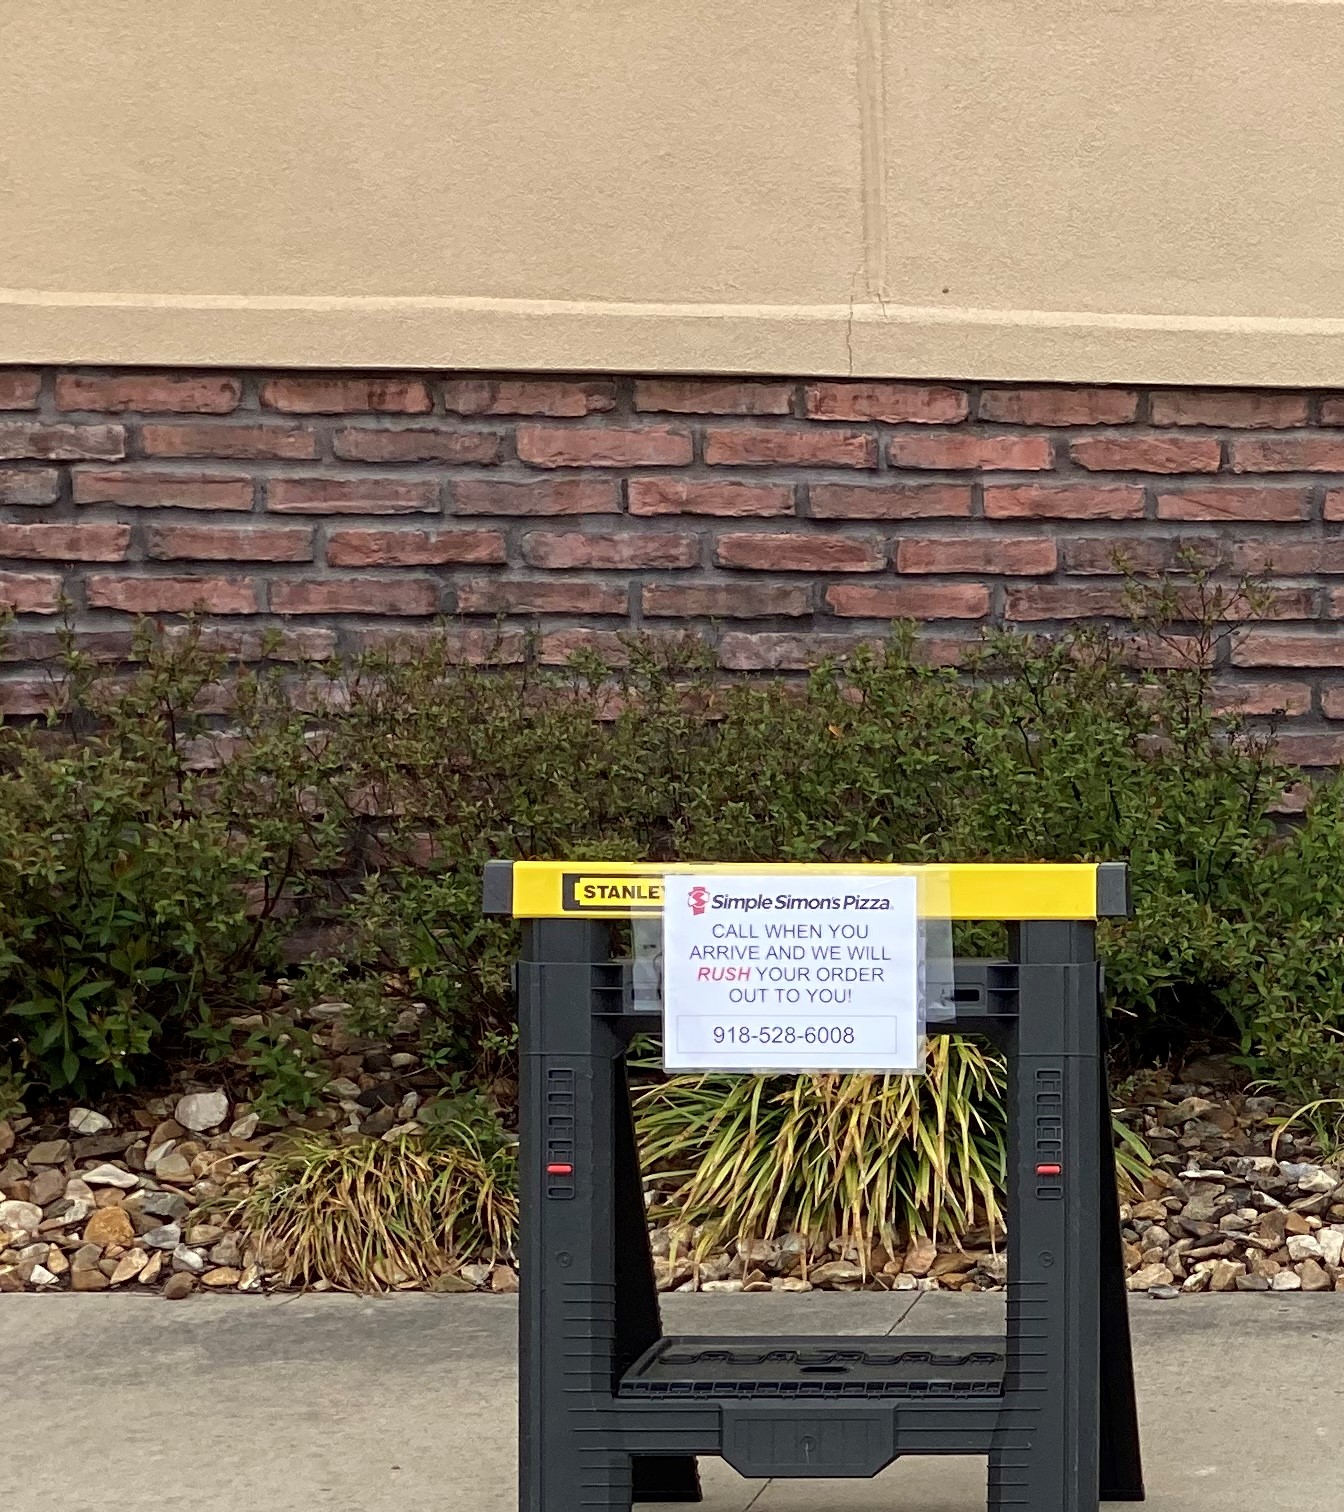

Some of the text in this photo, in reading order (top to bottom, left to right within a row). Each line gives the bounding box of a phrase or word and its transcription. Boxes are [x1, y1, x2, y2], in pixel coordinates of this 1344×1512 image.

[583, 885, 665, 899] STANLE
[711, 894, 891, 912] Simple Simon's Pizza
[712, 923, 869, 939] CALL WHEN YOU
[689, 945, 892, 960] ARRIVE AND WE WILL
[697, 966, 885, 982] RUSH YOUR ORDER
[728, 988, 852, 1003] OUT TO YOU!
[713, 1027, 855, 1044] 918-528-6008
